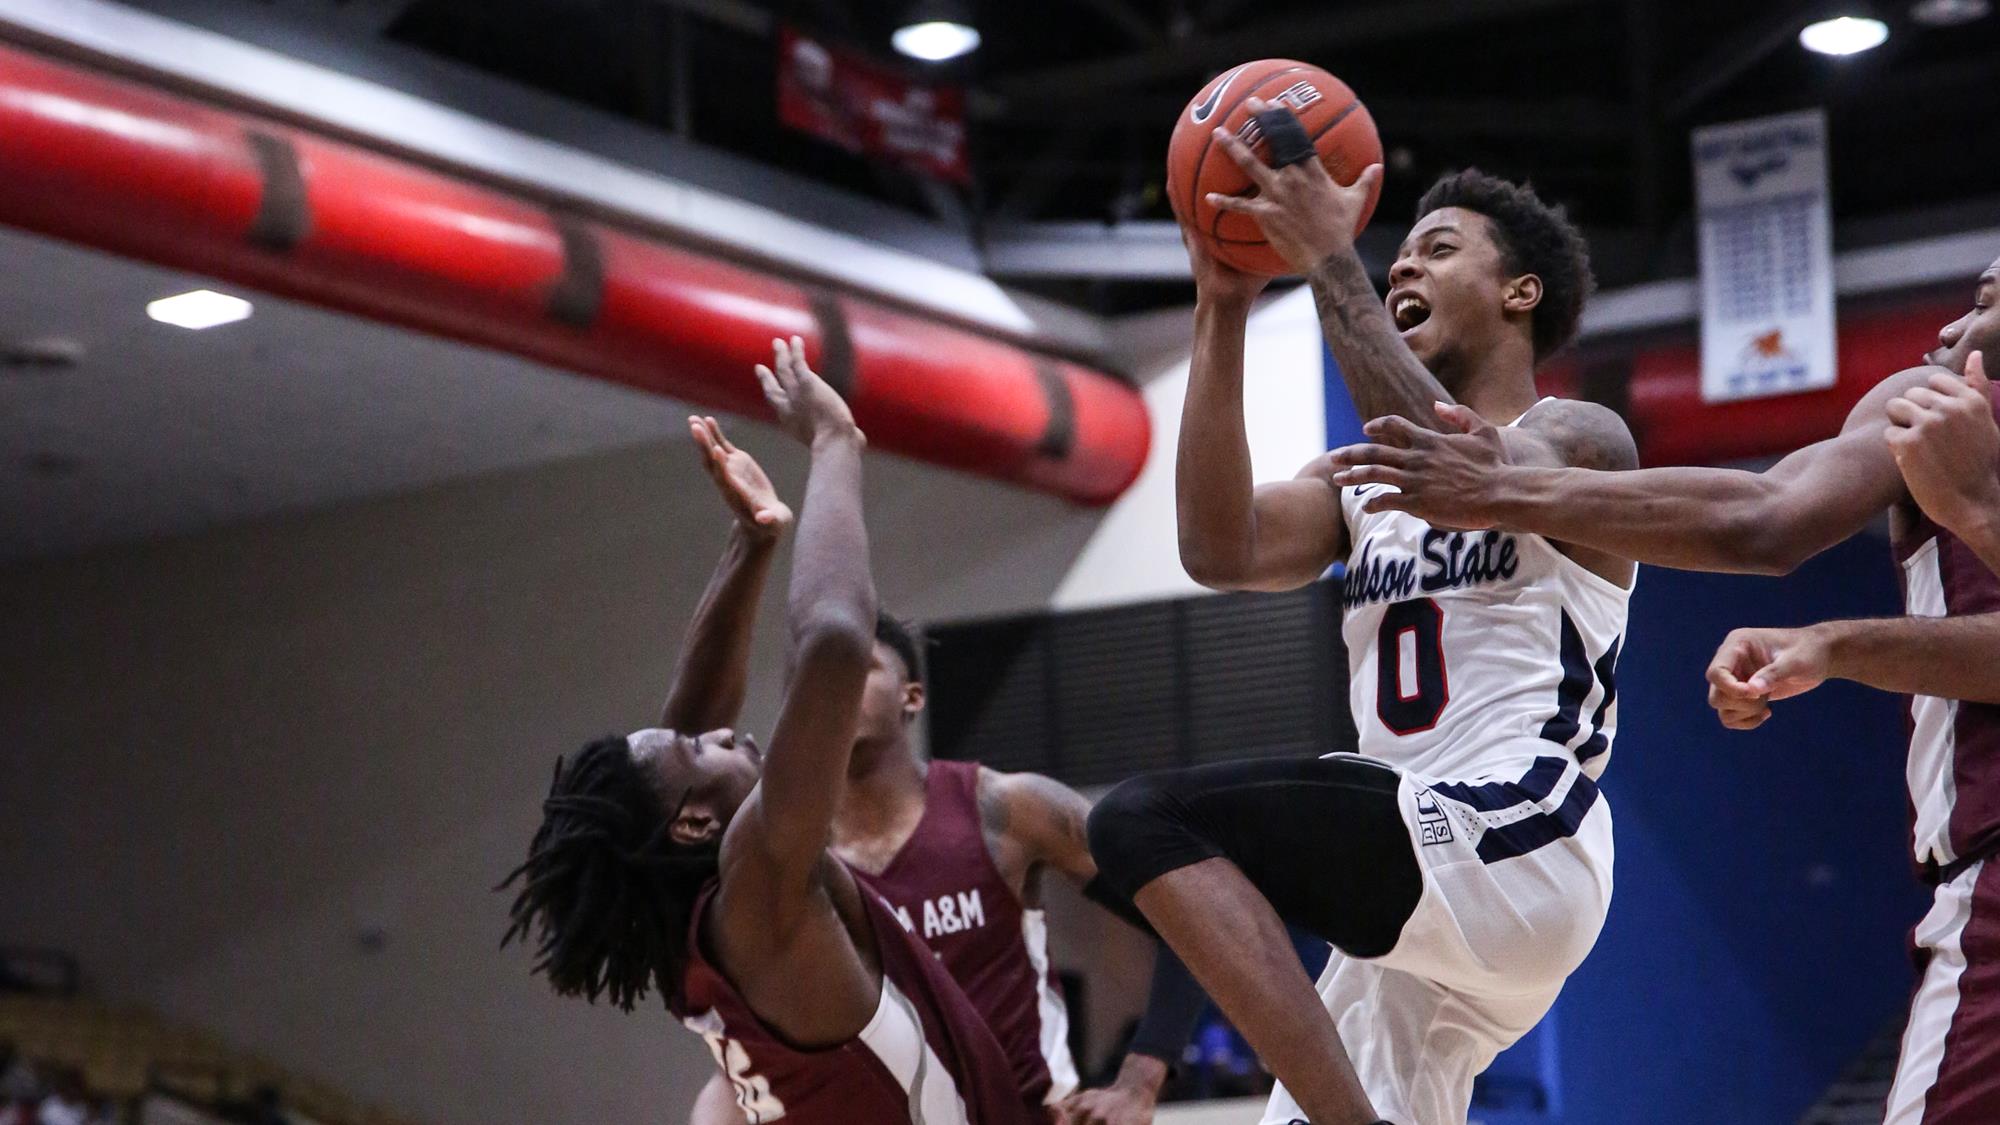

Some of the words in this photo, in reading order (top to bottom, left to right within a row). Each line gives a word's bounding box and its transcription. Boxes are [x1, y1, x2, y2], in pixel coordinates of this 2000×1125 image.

[1419, 529, 1520, 592] State
[1377, 598, 1449, 736] 0
[923, 889, 985, 939] A&M
